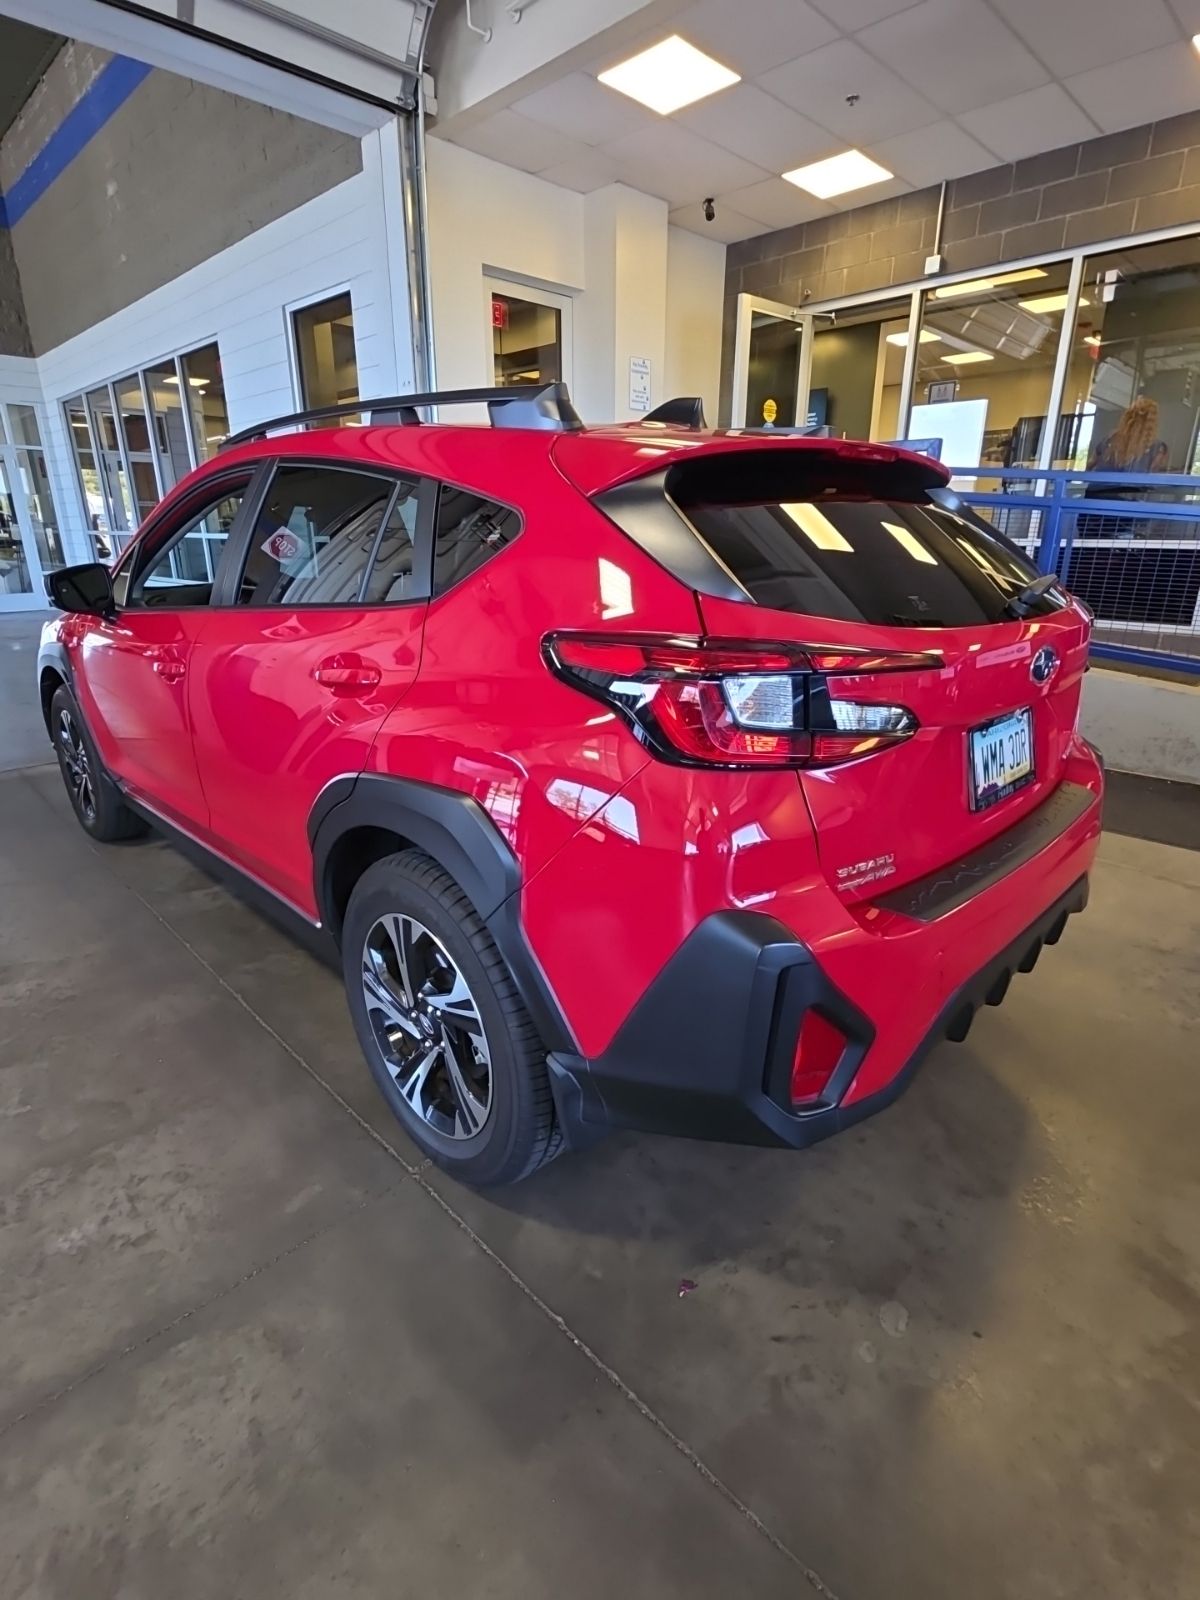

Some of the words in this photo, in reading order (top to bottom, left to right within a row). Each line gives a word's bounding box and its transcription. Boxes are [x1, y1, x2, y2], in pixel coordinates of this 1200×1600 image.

[981, 738, 1005, 784] WMA
[1008, 729, 1028, 770] 3DR
[836, 853, 894, 878] SUBARU
